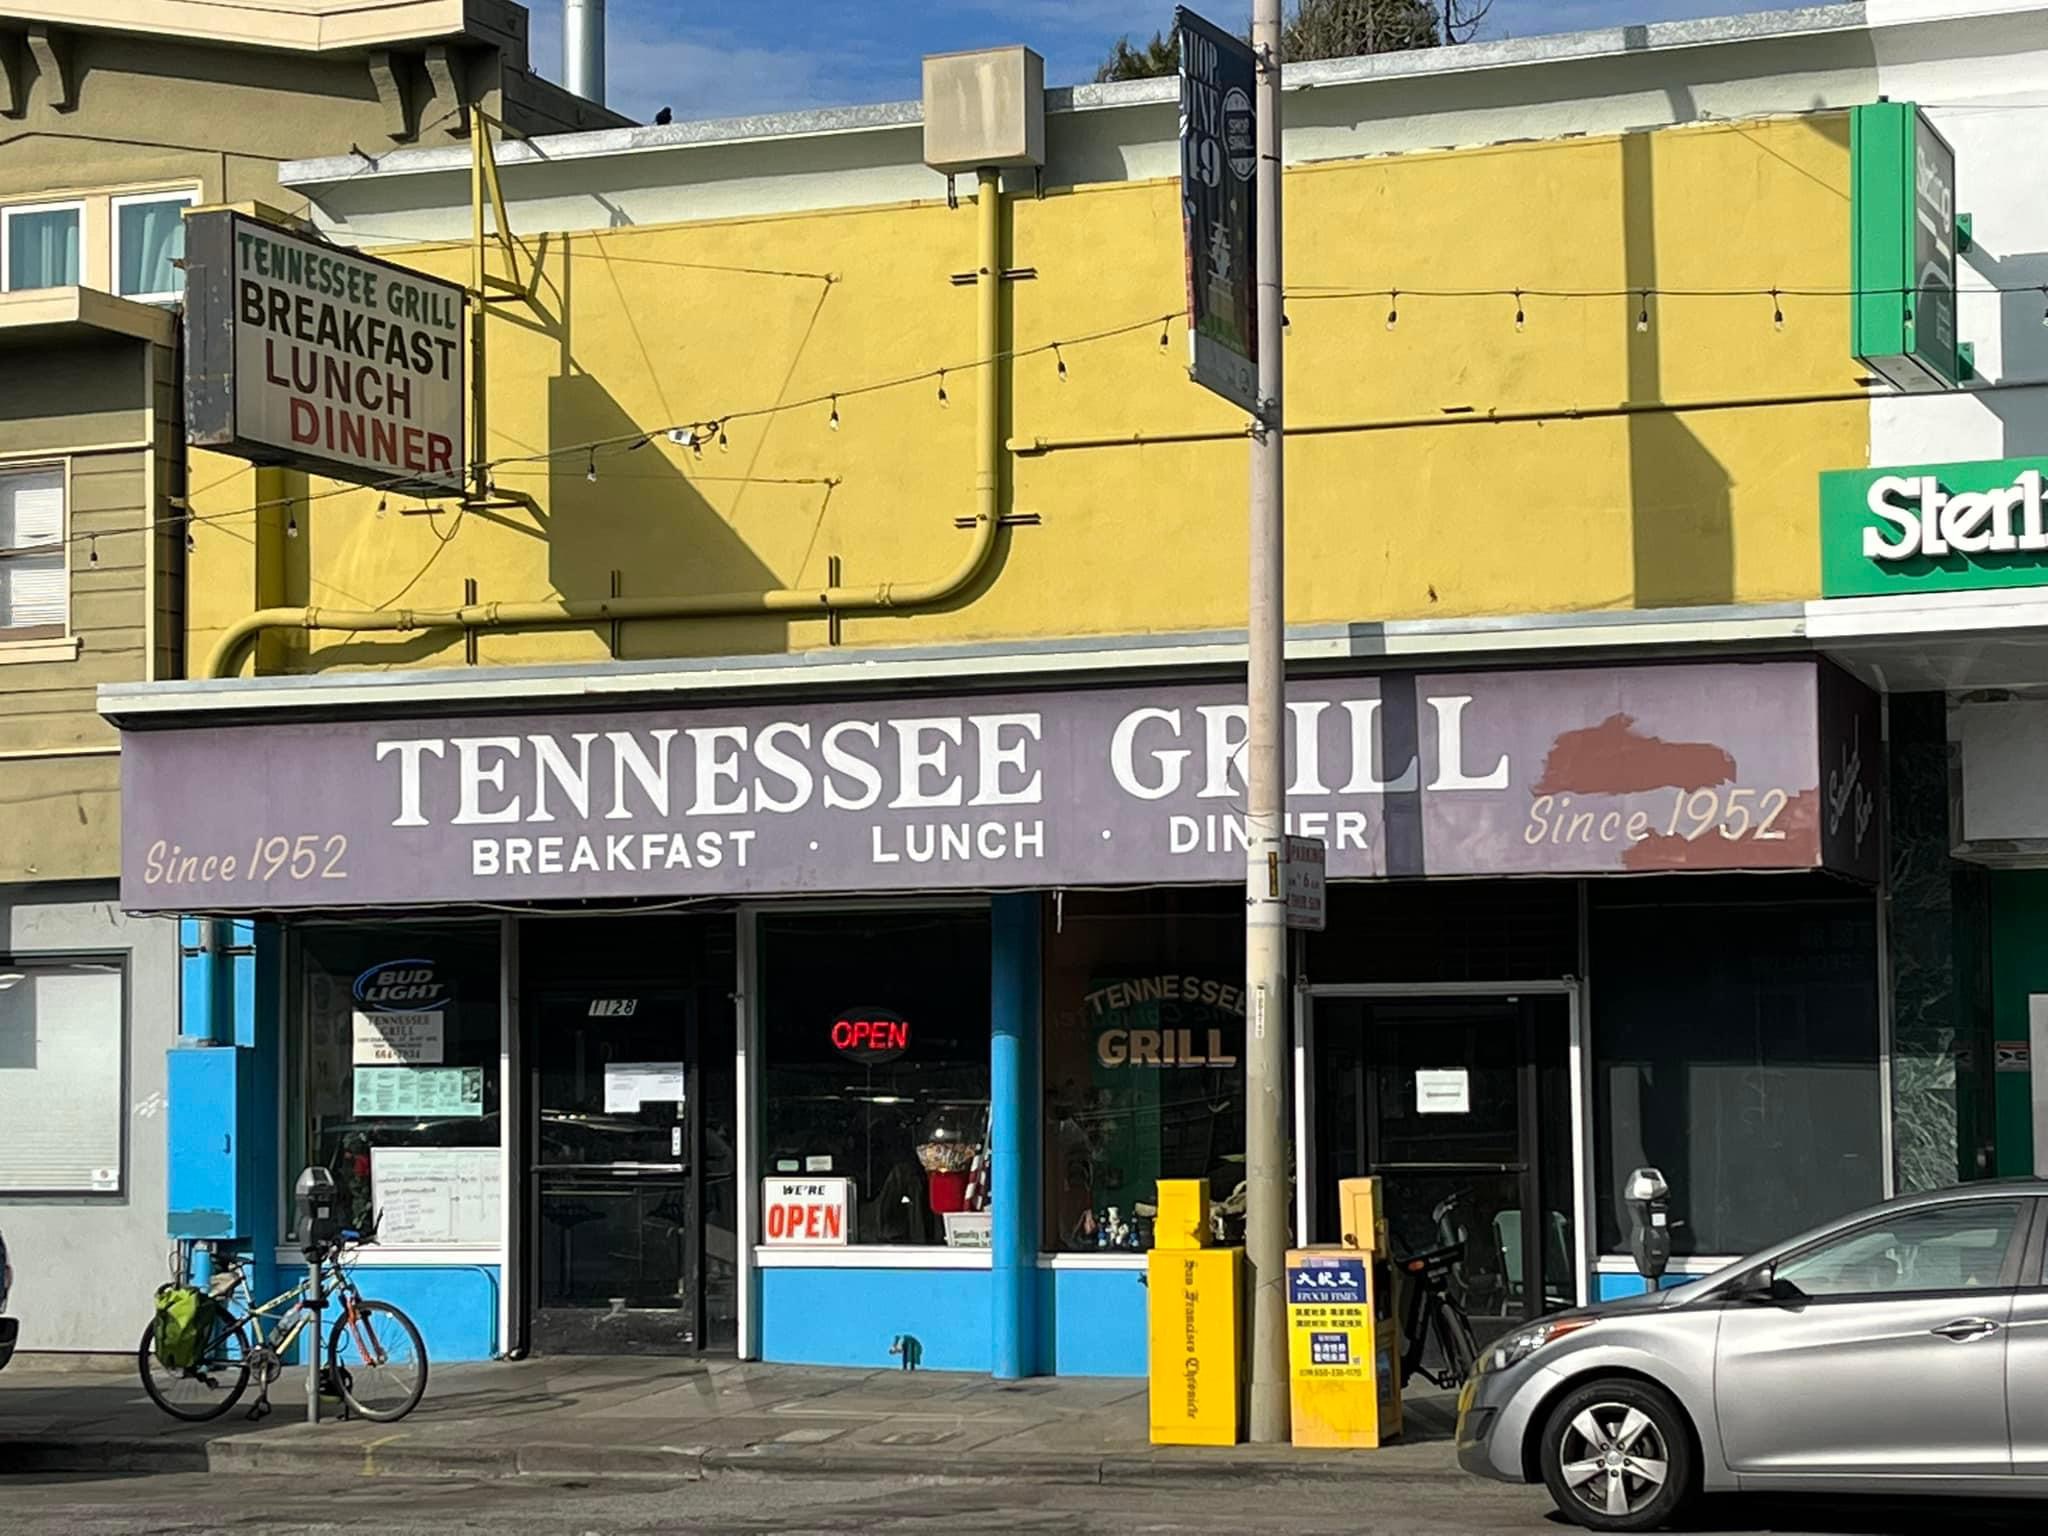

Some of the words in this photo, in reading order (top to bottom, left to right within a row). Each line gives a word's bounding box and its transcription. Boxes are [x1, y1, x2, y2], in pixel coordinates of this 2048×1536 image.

[238, 231, 378, 308] TENNESSEE
[387, 281, 457, 330] GRILL
[240, 278, 457, 381] BREAKFAST
[266, 338, 411, 419] LUNCH
[289, 396, 456, 478] DINNER
[1862, 470, 2048, 560] Sterl
[377, 712, 1044, 828] TENNESSEE
[1111, 695, 1508, 800] GRILL
[472, 830, 756, 876] BREAKFAST
[872, 820, 1044, 863] LUNCH
[1170, 811, 1368, 854] DINER
[1524, 795, 1649, 845] Since
[1666, 787, 1787, 842] 1952
[144, 839, 236, 884] Since
[247, 834, 349, 881] 1952
[365, 983, 444, 1001] LIGHT
[377, 970, 433, 986] BUD
[589, 999, 637, 1017] 1128
[831, 1020, 909, 1049] OPEN
[1097, 1028, 1237, 1069] GRILL
[783, 1184, 826, 1196] WE'RE
[768, 1203, 842, 1239] OPEN
[1184, 1287, 1199, 1352] Francisco
